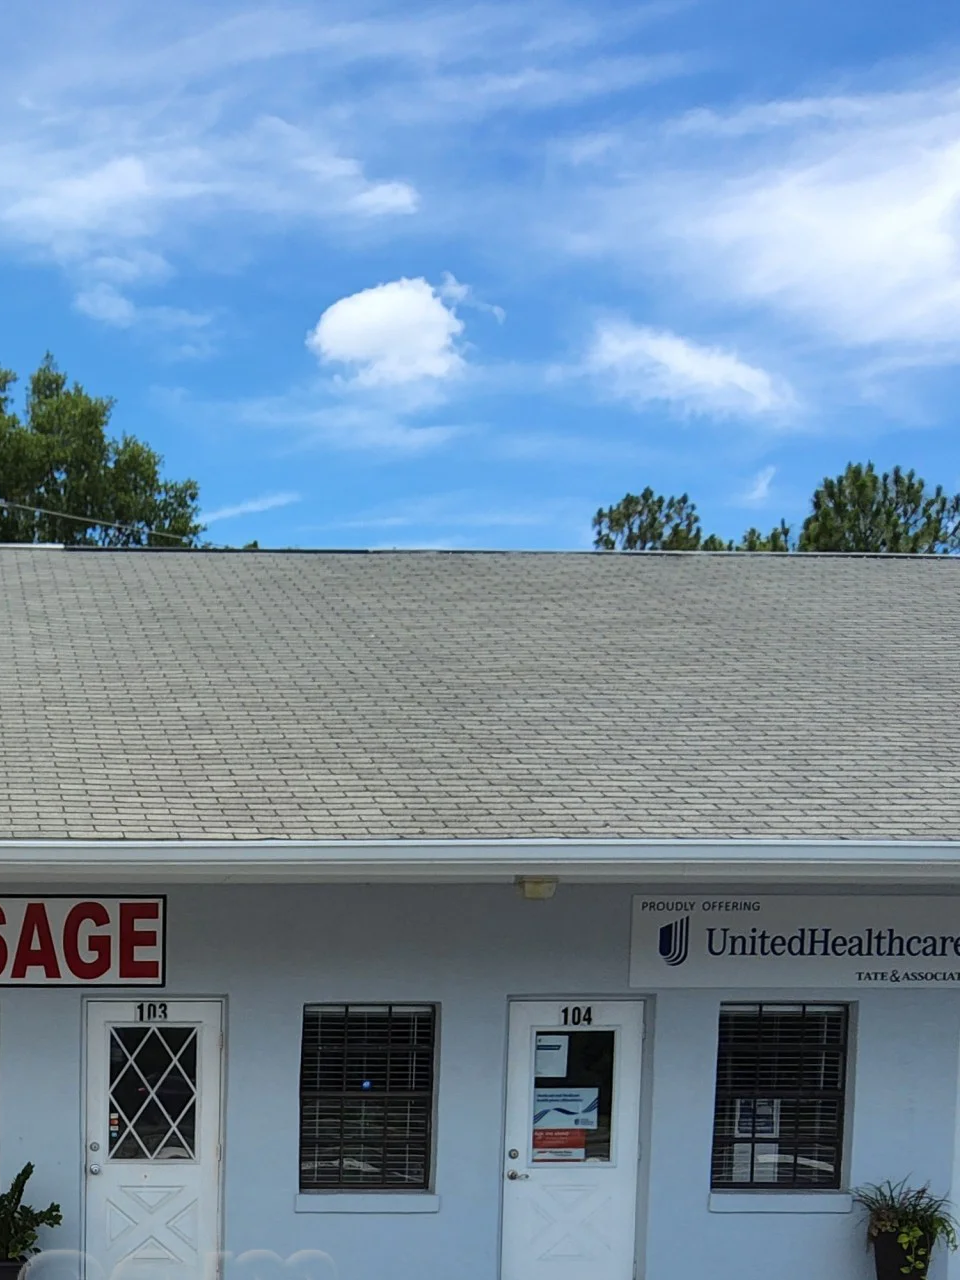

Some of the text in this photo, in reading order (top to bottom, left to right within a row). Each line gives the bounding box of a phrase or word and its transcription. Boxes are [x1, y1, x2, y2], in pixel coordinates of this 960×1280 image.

[641, 901, 761, 912] PROUDLY OFFERING
[136, 1002, 168, 1022] 103
[561, 1006, 592, 1026] 104
